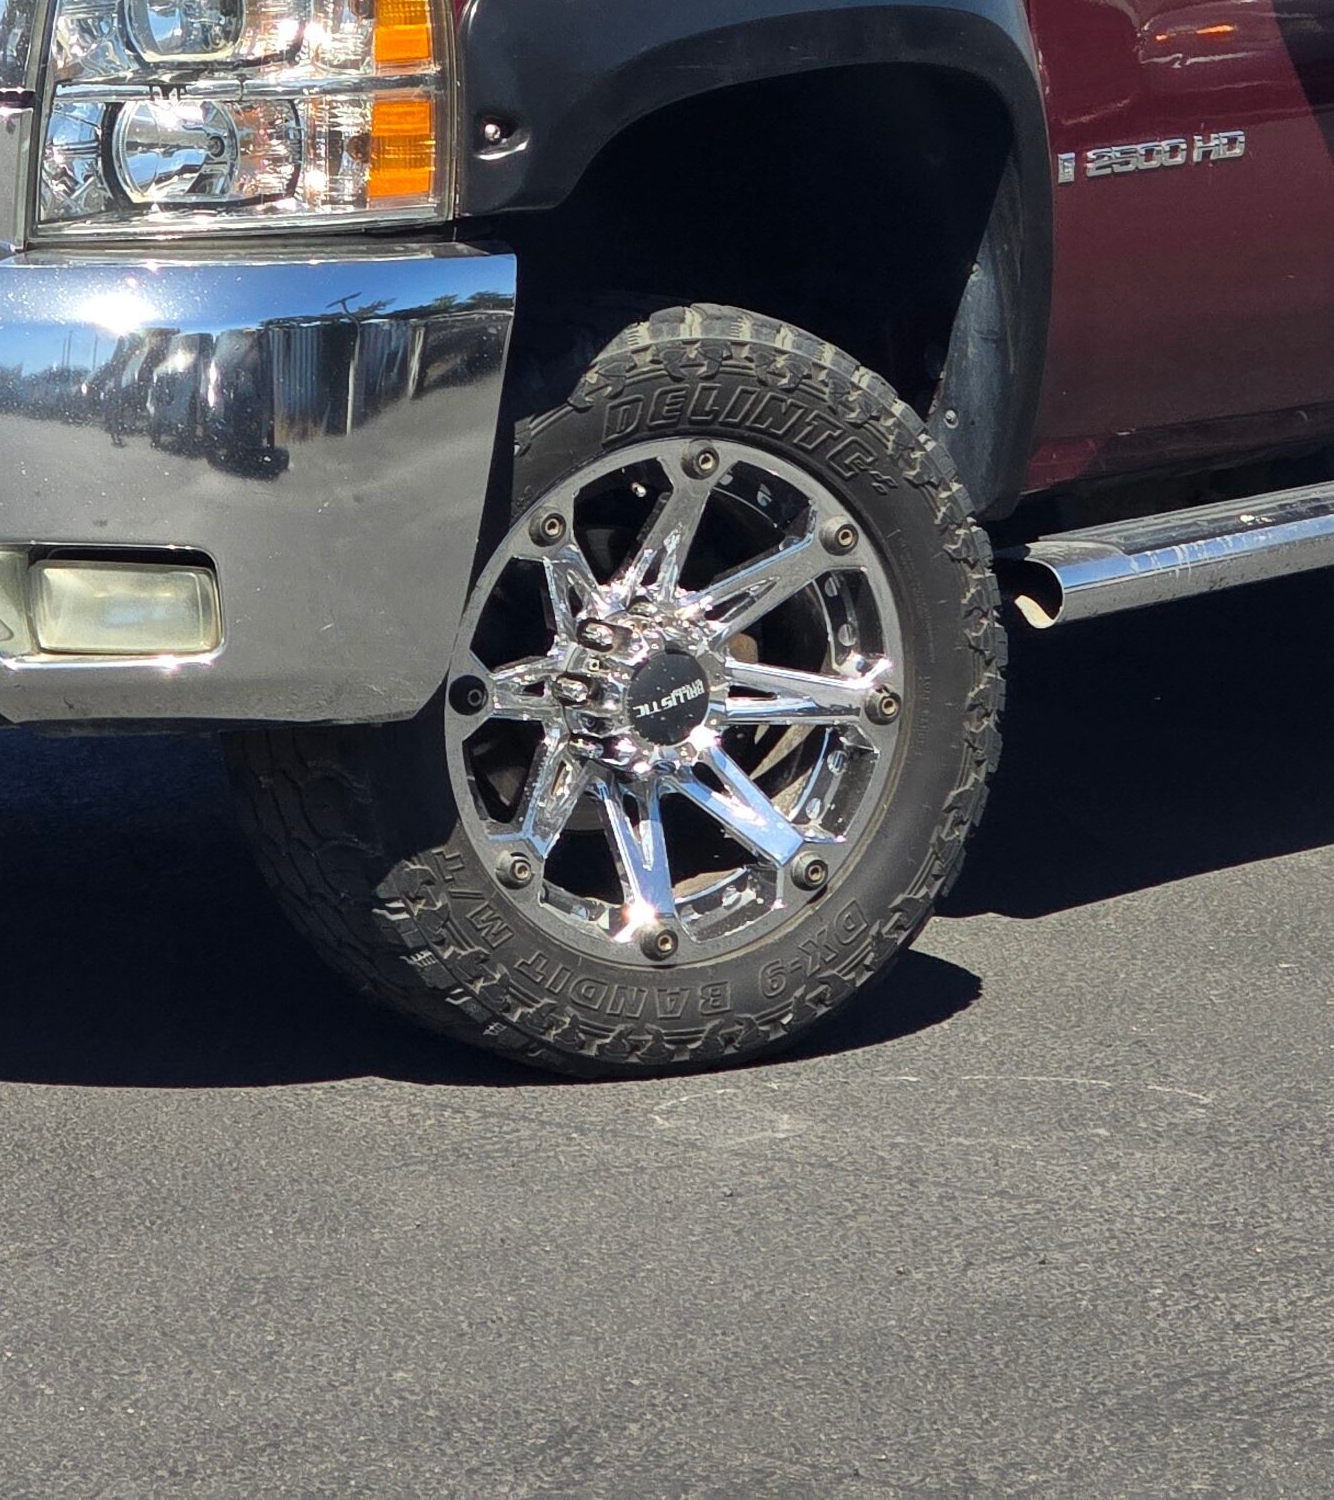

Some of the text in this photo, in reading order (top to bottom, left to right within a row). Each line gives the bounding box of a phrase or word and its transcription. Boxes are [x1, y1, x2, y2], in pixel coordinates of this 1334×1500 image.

[1086, 129, 1246, 178] 2500 HD
[513, 949, 732, 1020] BANDIT
[757, 898, 869, 1000] DX-9
